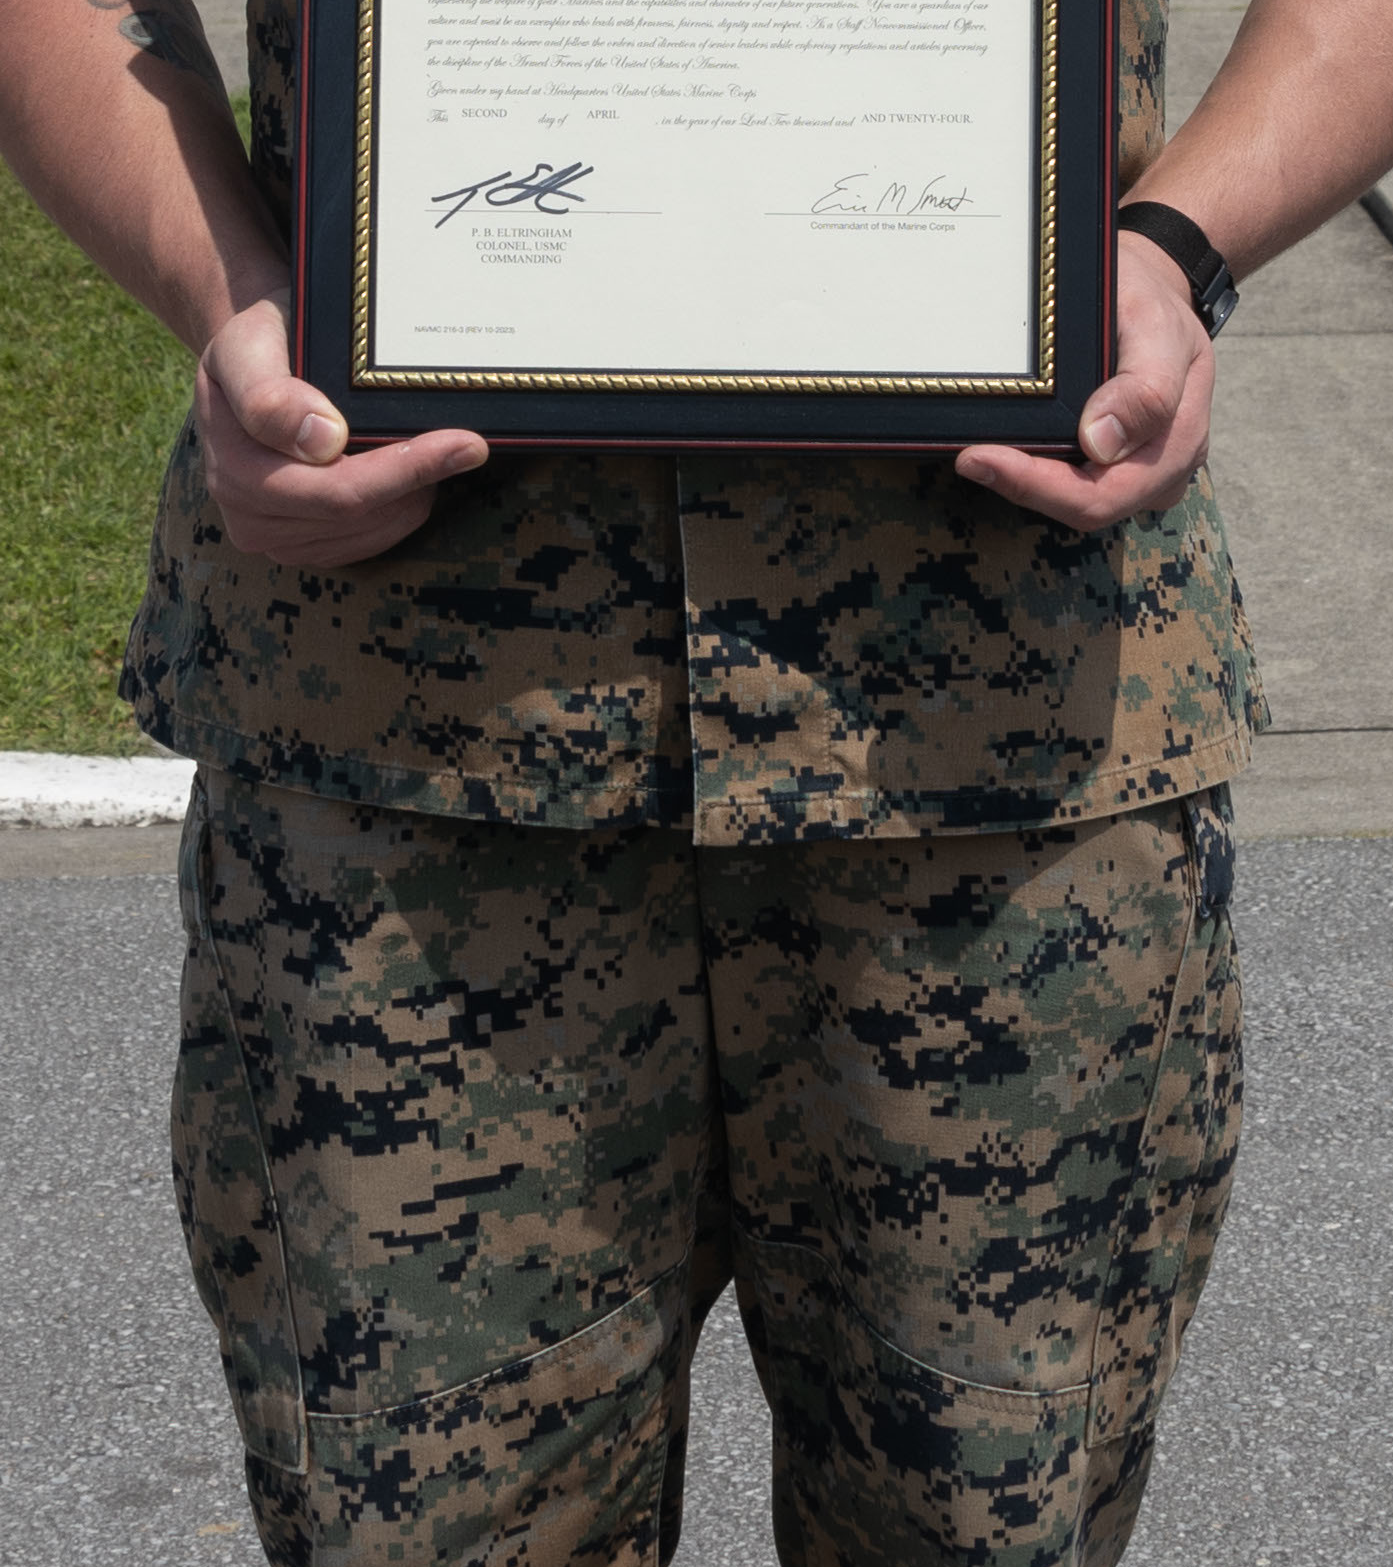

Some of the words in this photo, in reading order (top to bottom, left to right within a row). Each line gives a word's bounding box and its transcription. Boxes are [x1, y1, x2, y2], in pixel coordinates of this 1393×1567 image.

[461, 108, 508, 118] SECOND
[586, 110, 620, 119] APRIL
[861, 114, 886, 124] AND
[889, 114, 974, 124] TWENTY-FOUR.
[810, 221, 868, 231] Commandant
[870, 221, 880, 230] of
[881, 221, 896, 231] the
[898, 222, 927, 231] Marine
[929, 222, 956, 232] Corps
[471, 228, 480, 237] P.
[484, 228, 494, 237] B.
[497, 228, 572, 238] ELTRINGHAM
[475, 241, 532, 251] COLONEL,
[535, 242, 567, 252] USMC
[480, 254, 562, 264] COMMANDING
[465, 326, 482, 335] (REV
[484, 326, 515, 335] 10-2023)
